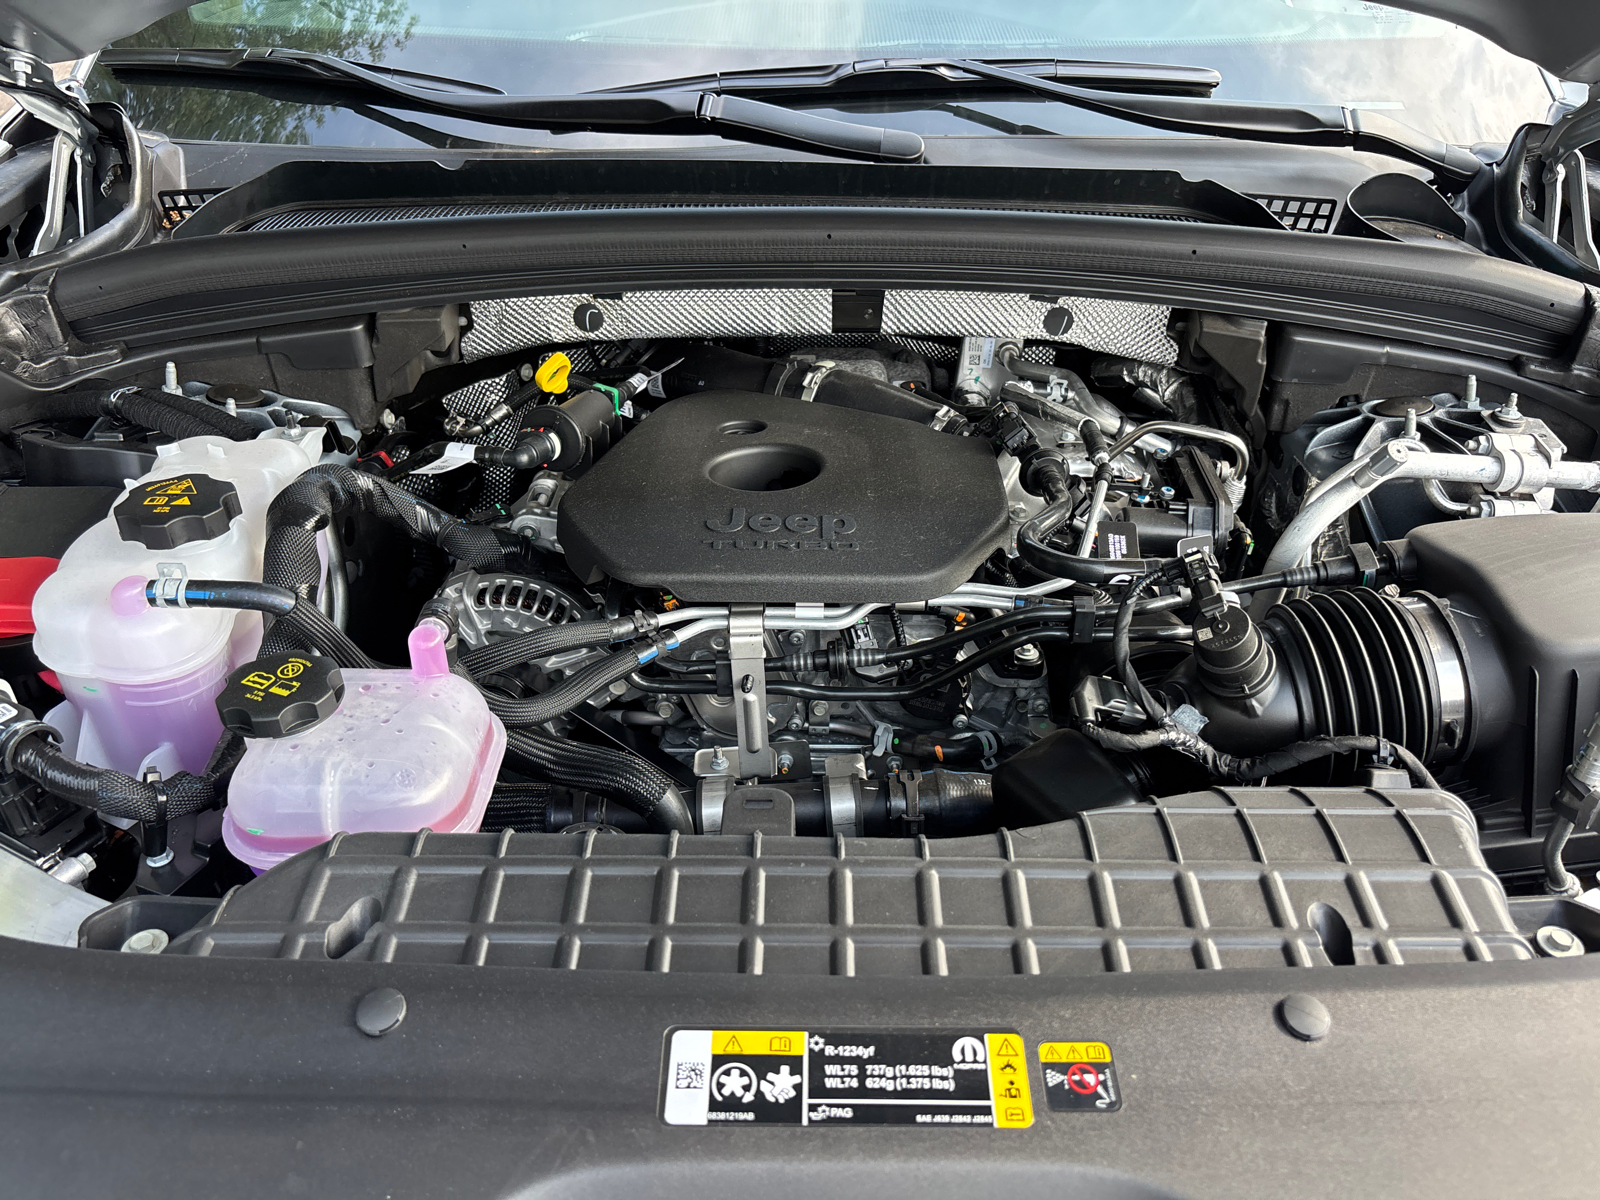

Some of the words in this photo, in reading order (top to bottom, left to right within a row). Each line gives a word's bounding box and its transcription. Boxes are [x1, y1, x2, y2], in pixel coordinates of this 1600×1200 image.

[705, 508, 857, 540] Jeep
[702, 539, 860, 550] TURBO
[824, 1046, 875, 1059] R-1234yf
[824, 1065, 859, 1076] WL75
[865, 1065, 894, 1077] 737g
[895, 1065, 930, 1077] (1.625
[931, 1065, 954, 1078] lbs)
[824, 1078, 859, 1088] WL74
[865, 1078, 895, 1091] 624g
[896, 1078, 930, 1091] (1.375
[932, 1078, 956, 1092] lbs)
[707, 1112, 755, 1120] 68381219AB
[830, 1108, 853, 1118] PAG
[916, 1114, 932, 1122] SAE
